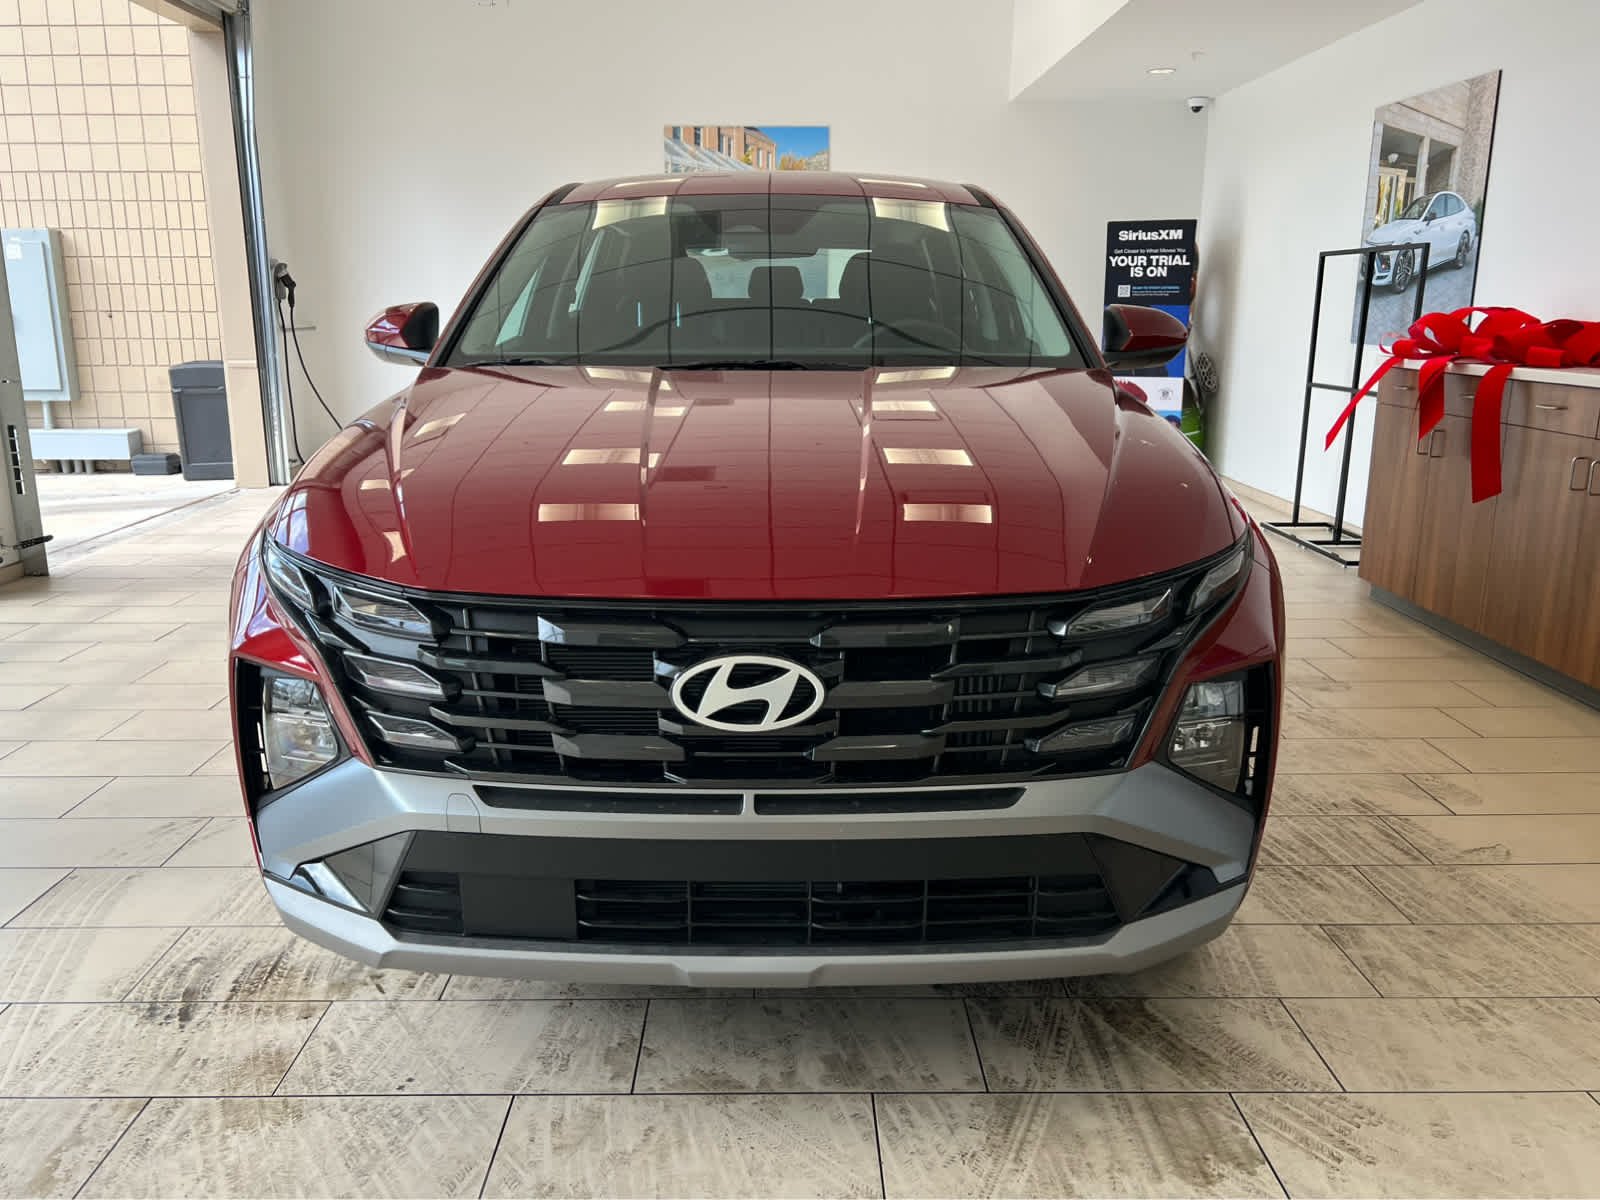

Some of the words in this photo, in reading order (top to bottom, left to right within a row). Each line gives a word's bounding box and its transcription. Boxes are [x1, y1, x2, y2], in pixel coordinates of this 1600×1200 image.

[1118, 229, 1184, 241] SiriusXM
[1109, 255, 1147, 267] YOUR
[1150, 254, 1191, 266] TRIAL
[1130, 266, 1144, 277] IS
[1146, 266, 1168, 277] ON
